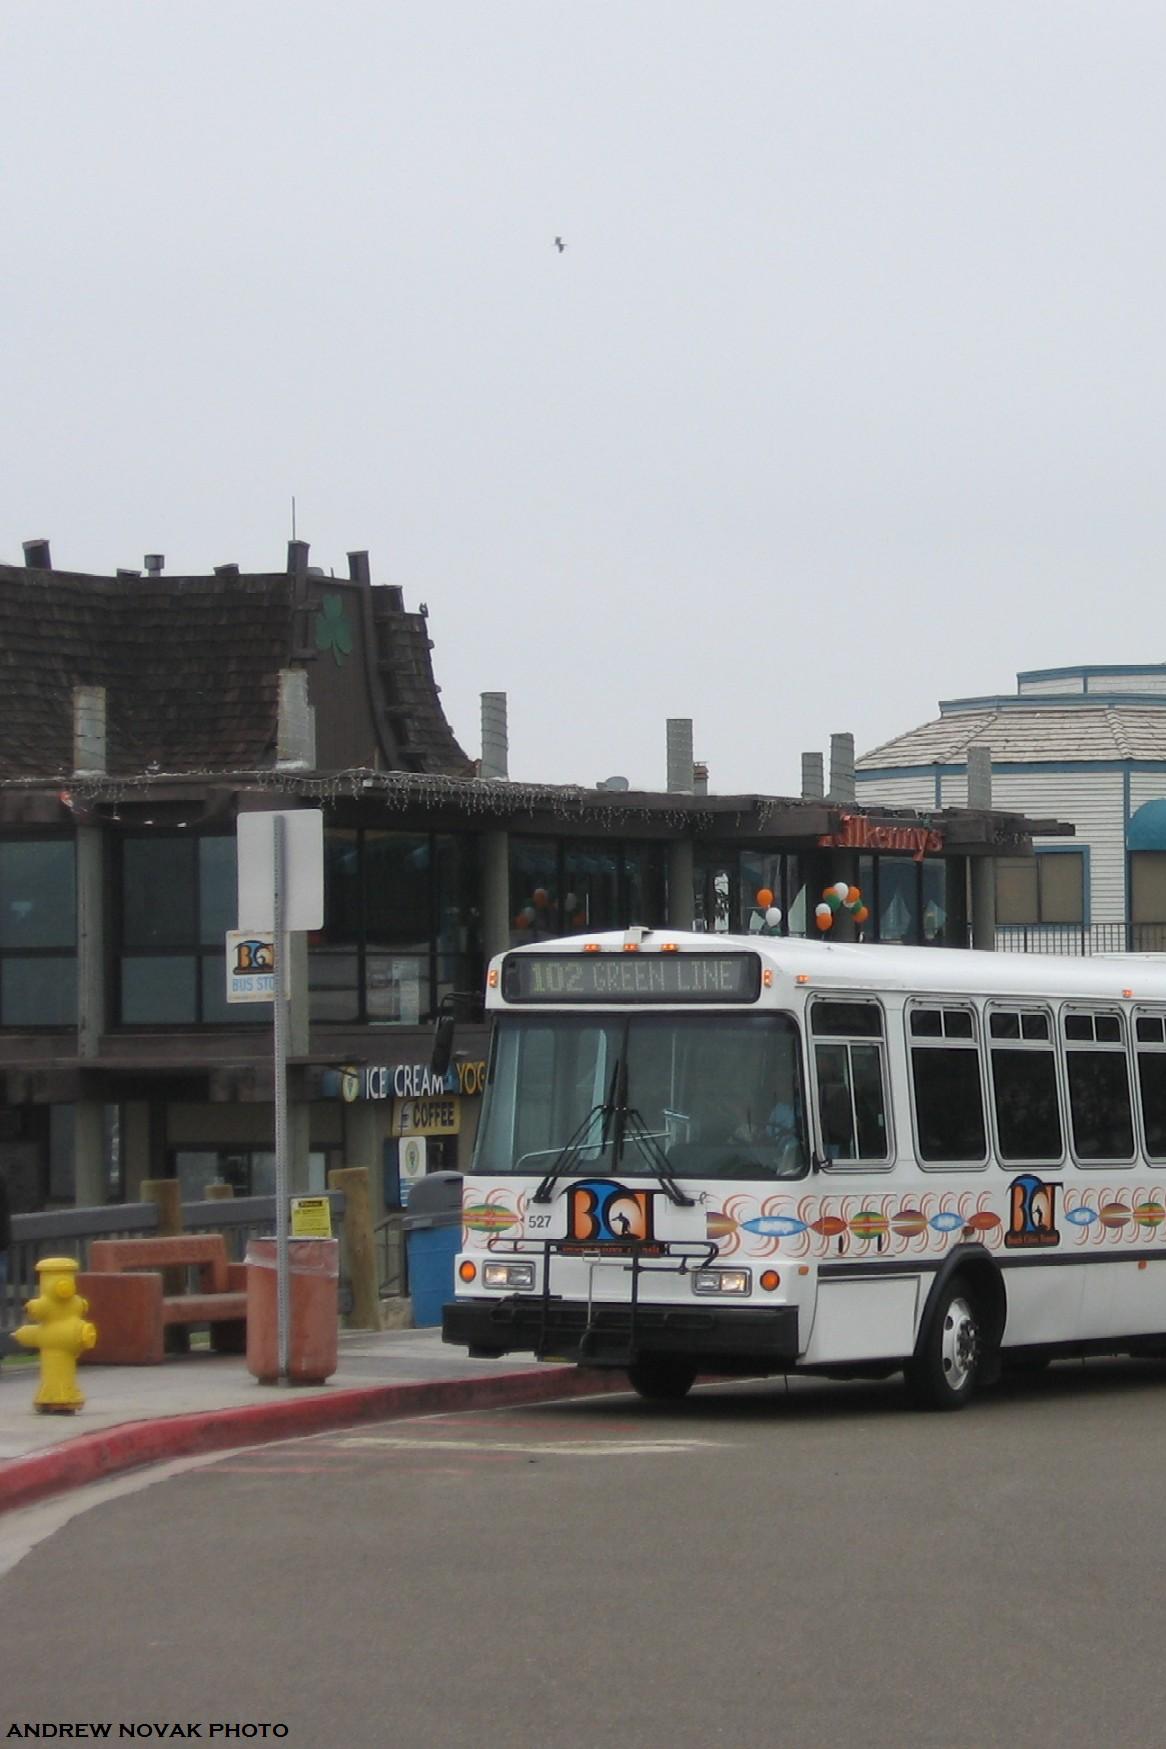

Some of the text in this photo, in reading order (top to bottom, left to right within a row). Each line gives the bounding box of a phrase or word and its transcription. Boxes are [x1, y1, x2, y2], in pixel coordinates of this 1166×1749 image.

[232, 976, 275, 993] BUS STO
[531, 960, 733, 993] 102 GREEN LINE
[366, 1060, 486, 1099] ICE CREAM YOG
[413, 1101, 455, 1128] COFFEE
[528, 1215, 551, 1229] 527
